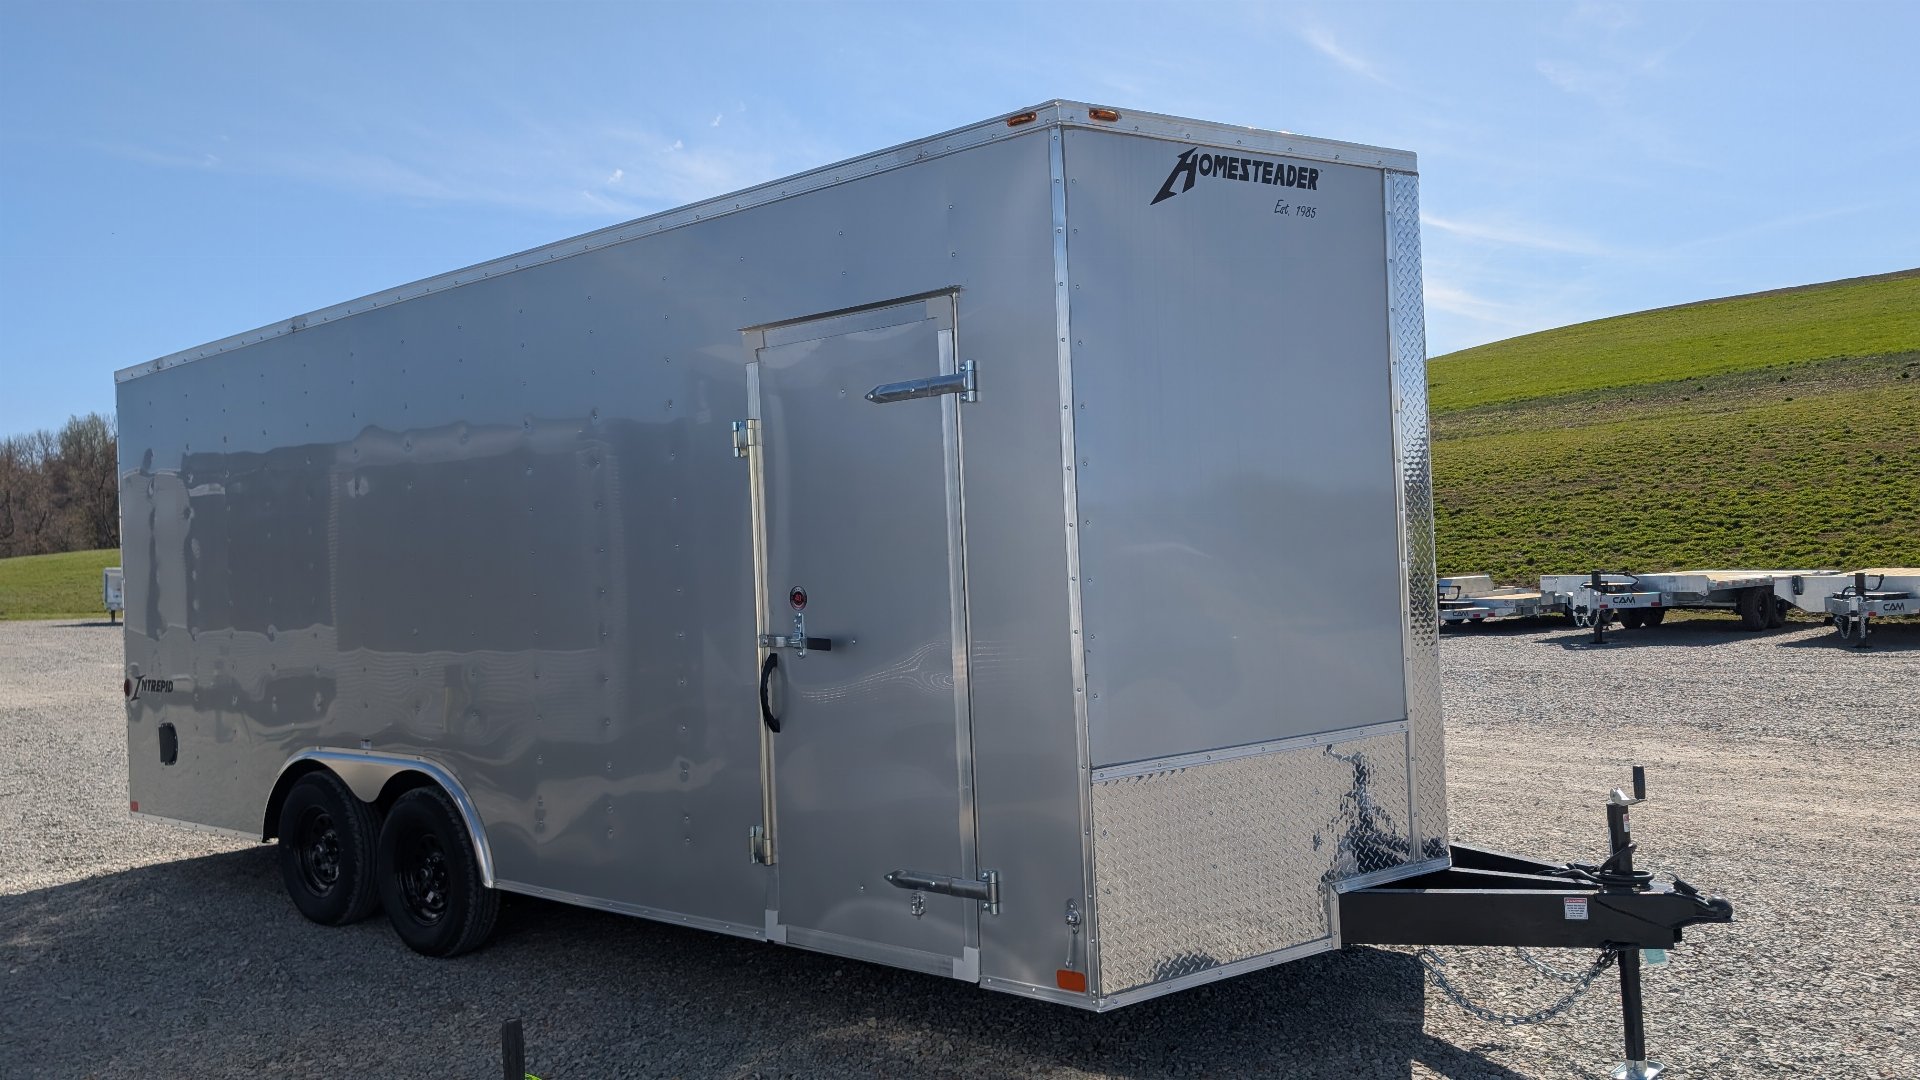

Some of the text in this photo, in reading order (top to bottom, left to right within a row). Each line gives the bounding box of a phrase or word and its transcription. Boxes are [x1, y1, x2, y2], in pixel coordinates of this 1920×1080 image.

[1150, 147, 1319, 206] HOMESTEADER
[1296, 206, 1317, 218] 1985
[1883, 602, 1904, 611] CAM
[131, 674, 174, 701] INTREPID
